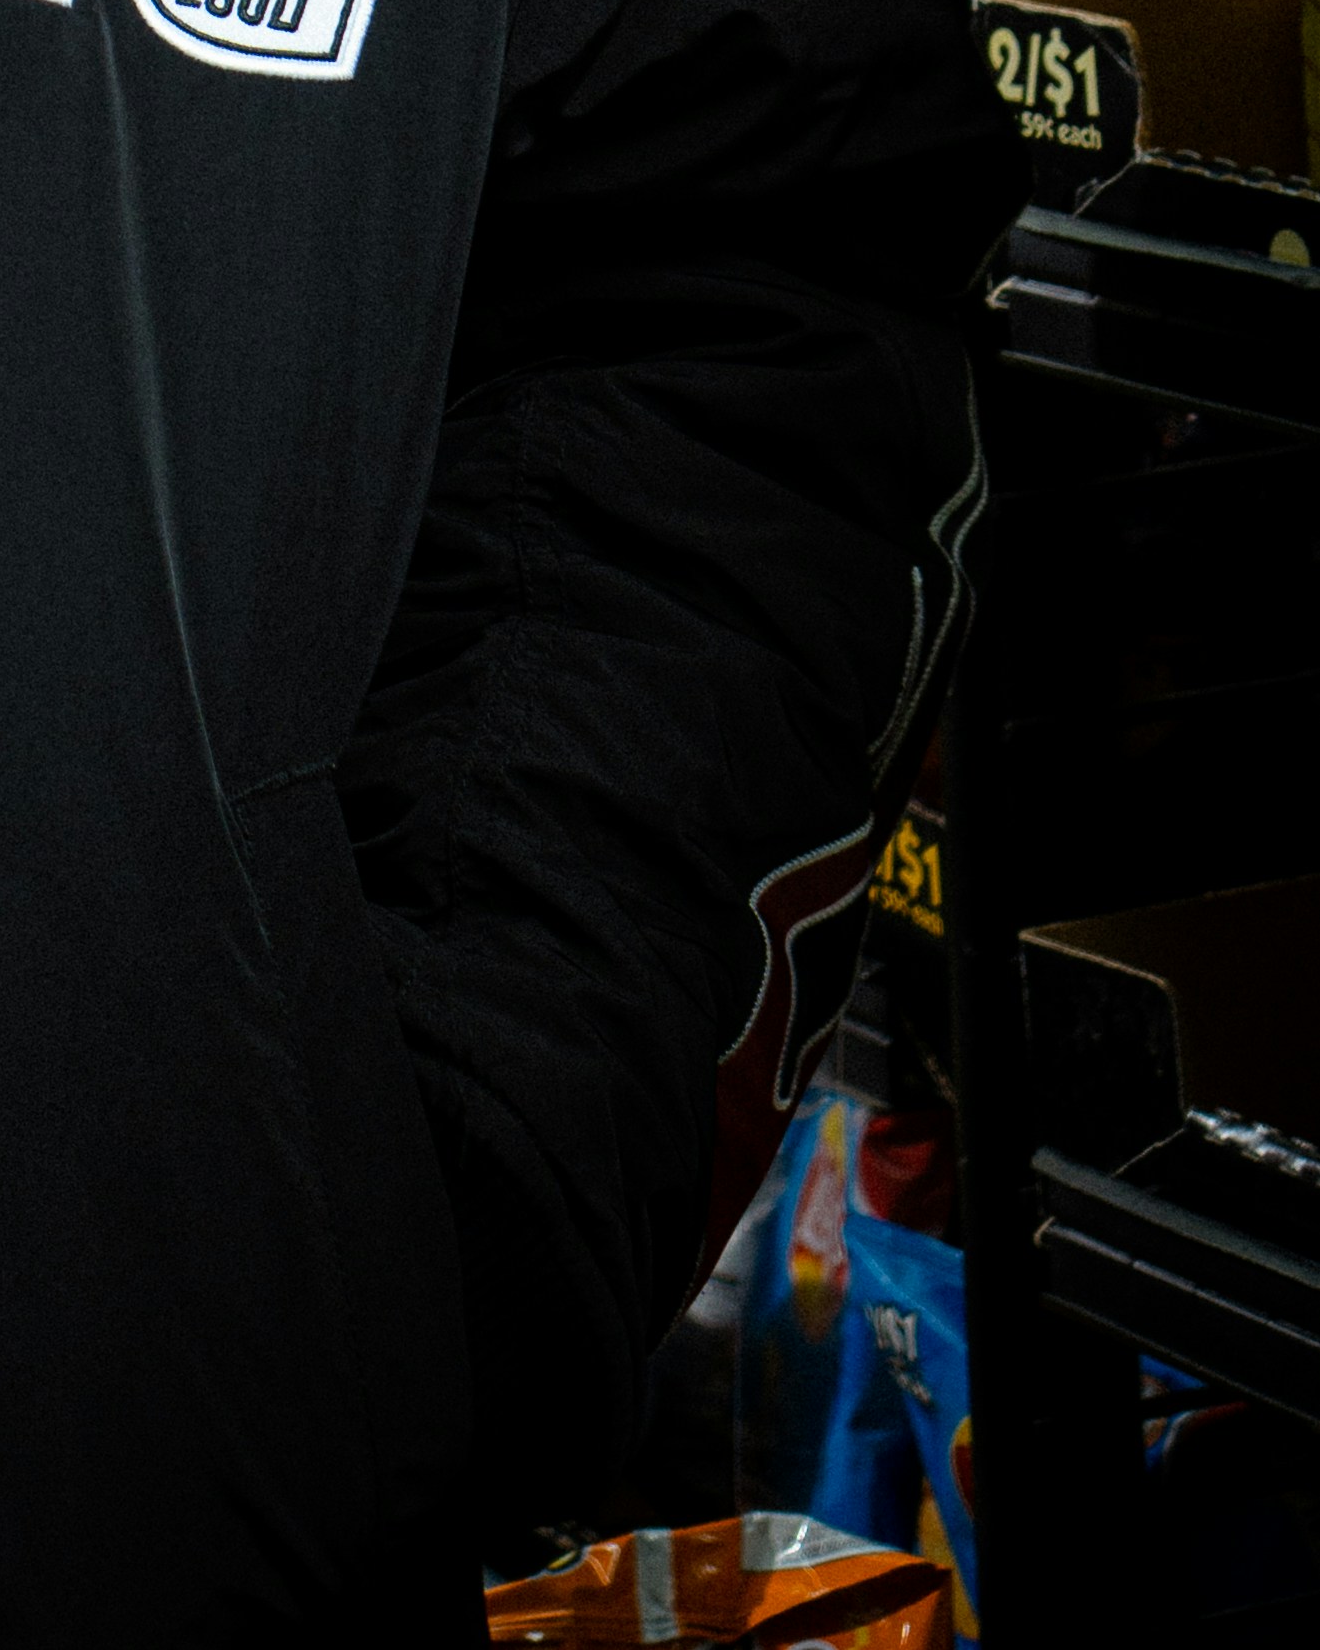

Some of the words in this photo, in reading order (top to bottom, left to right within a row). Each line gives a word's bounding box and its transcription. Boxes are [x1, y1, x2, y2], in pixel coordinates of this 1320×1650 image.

[988, 26, 1101, 118] 2/$1
[1057, 121, 1103, 151] each
[875, 819, 943, 908] /$1
